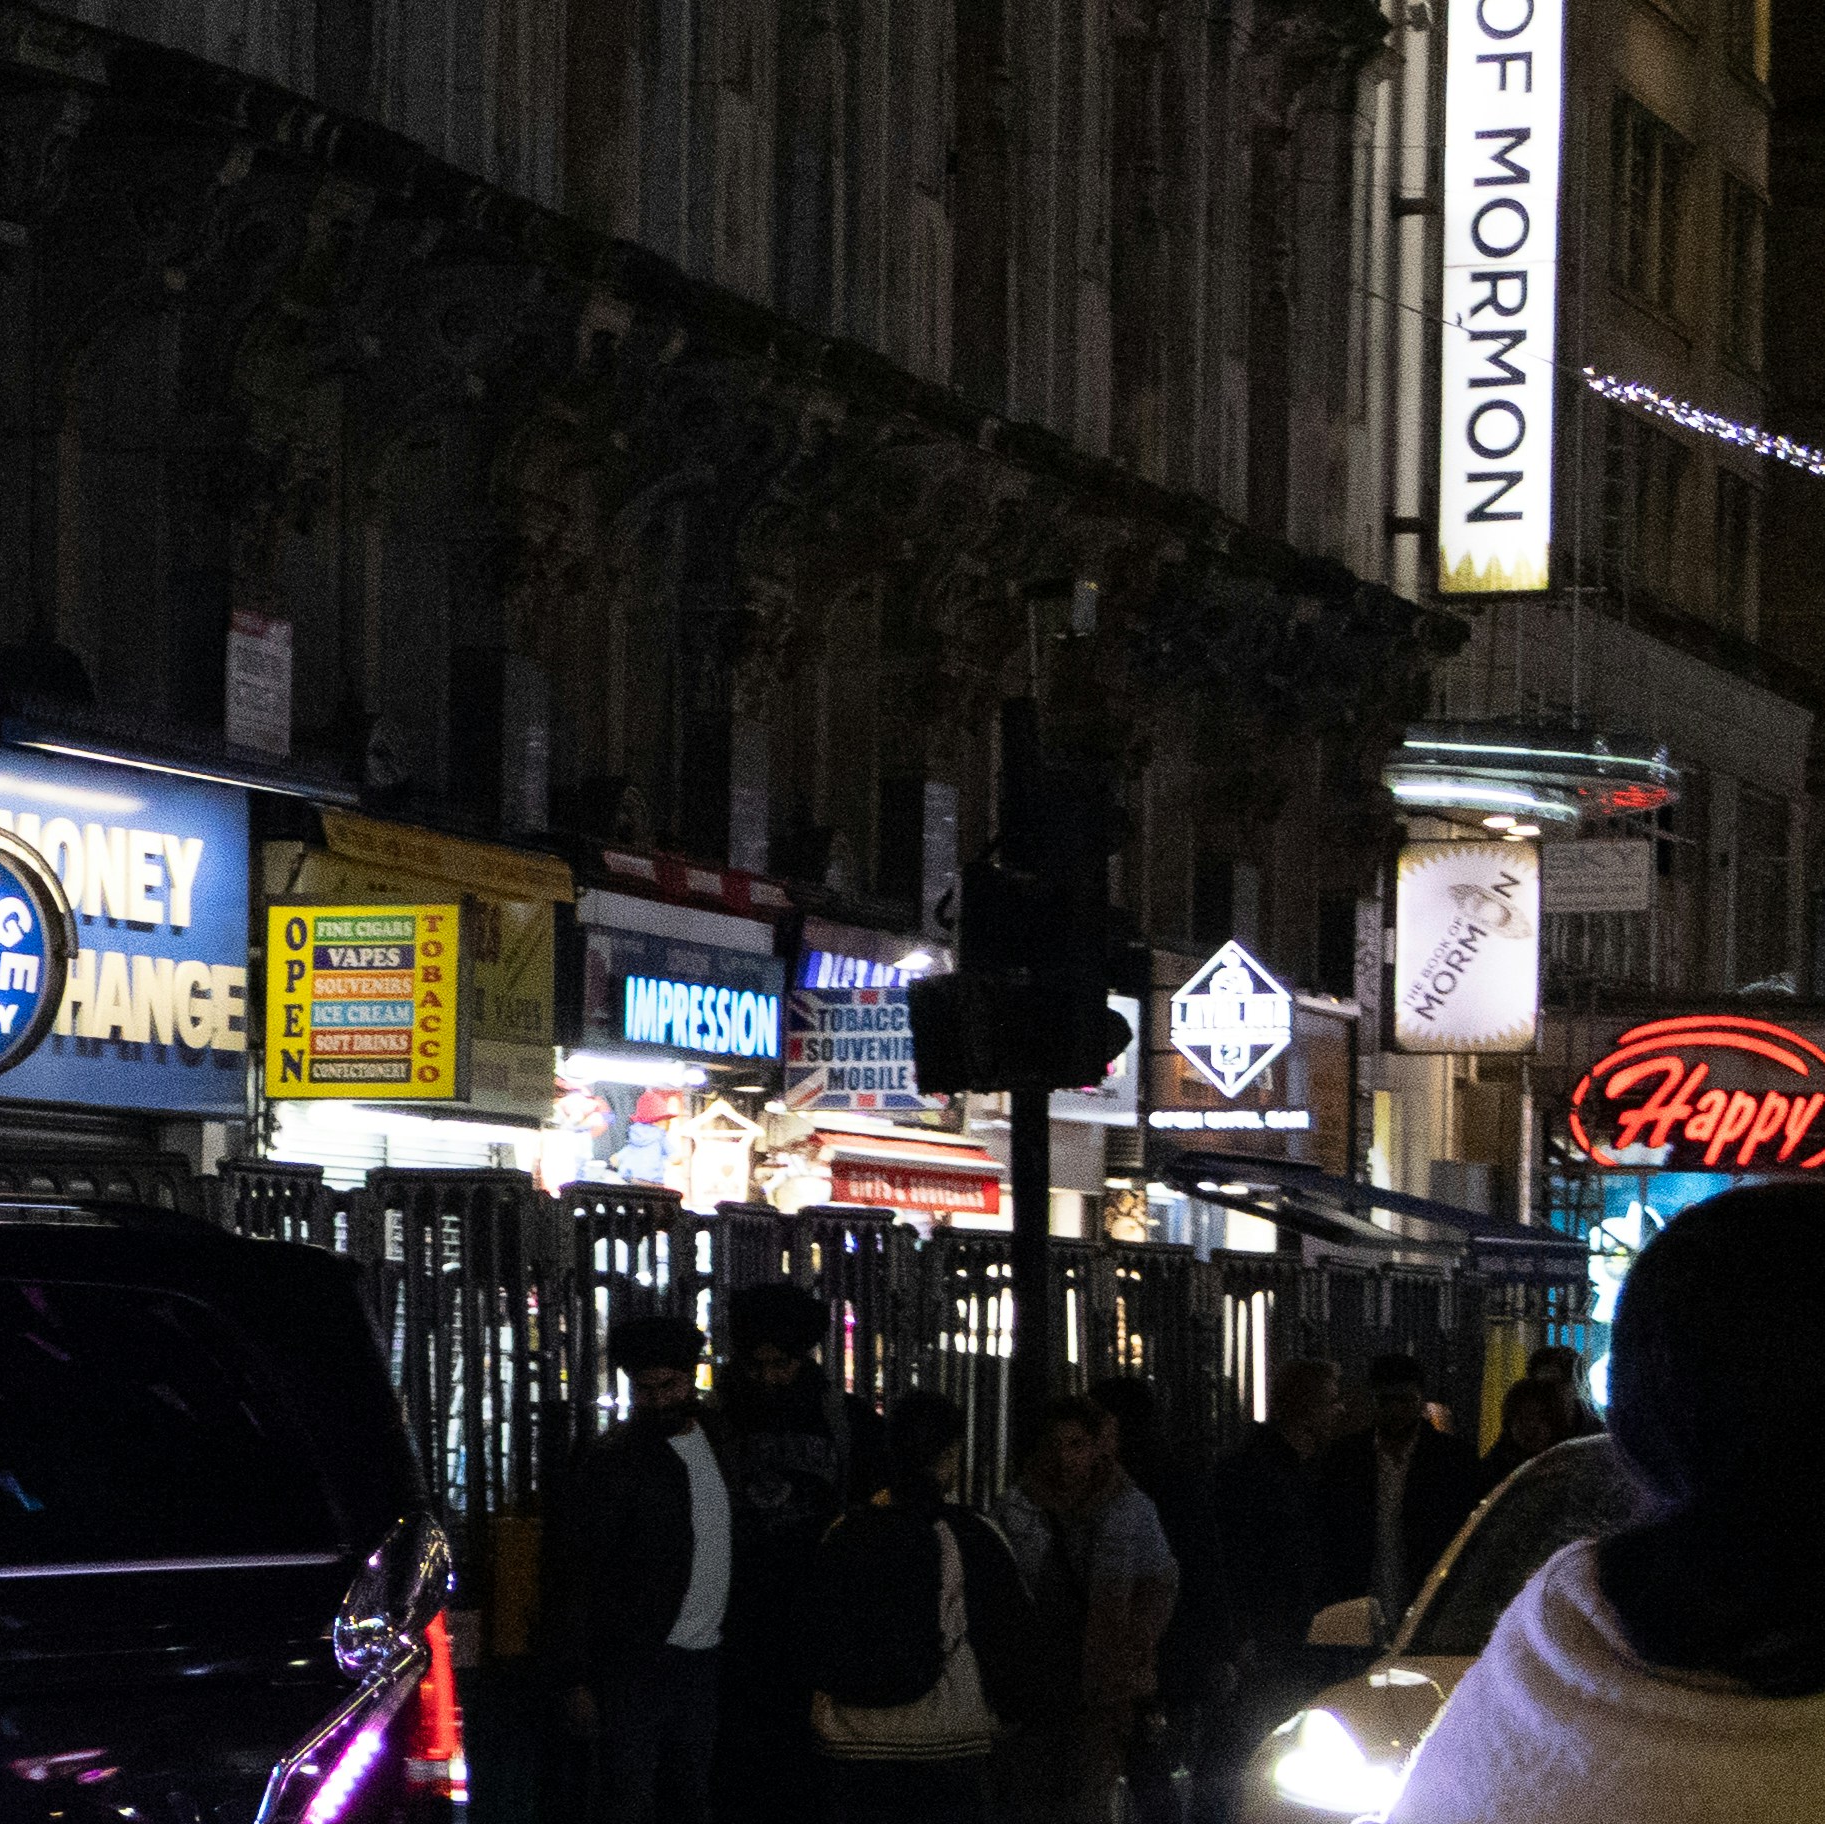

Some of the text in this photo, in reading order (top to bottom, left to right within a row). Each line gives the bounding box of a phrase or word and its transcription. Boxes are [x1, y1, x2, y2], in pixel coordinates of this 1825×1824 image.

[1464, 0, 1535, 524] OF MORMON
[317, 921, 414, 938] FINE CIGARS
[327, 947, 402, 968] VAPES
[279, 916, 309, 1083] OPEN
[314, 976, 413, 995] SOUVENIRS
[417, 914, 444, 1084] TOBACCO
[53, 948, 249, 1052] HANGE
[314, 1004, 411, 1024] ICE CREAM
[624, 974, 781, 1058] IMPRESSION
[816, 1005, 905, 1033] TOBACC
[314, 1033, 410, 1052] SOFT DRINKS
[827, 1066, 907, 1091] MOBILE
[1605, 1055, 1825, 1167] Happy
